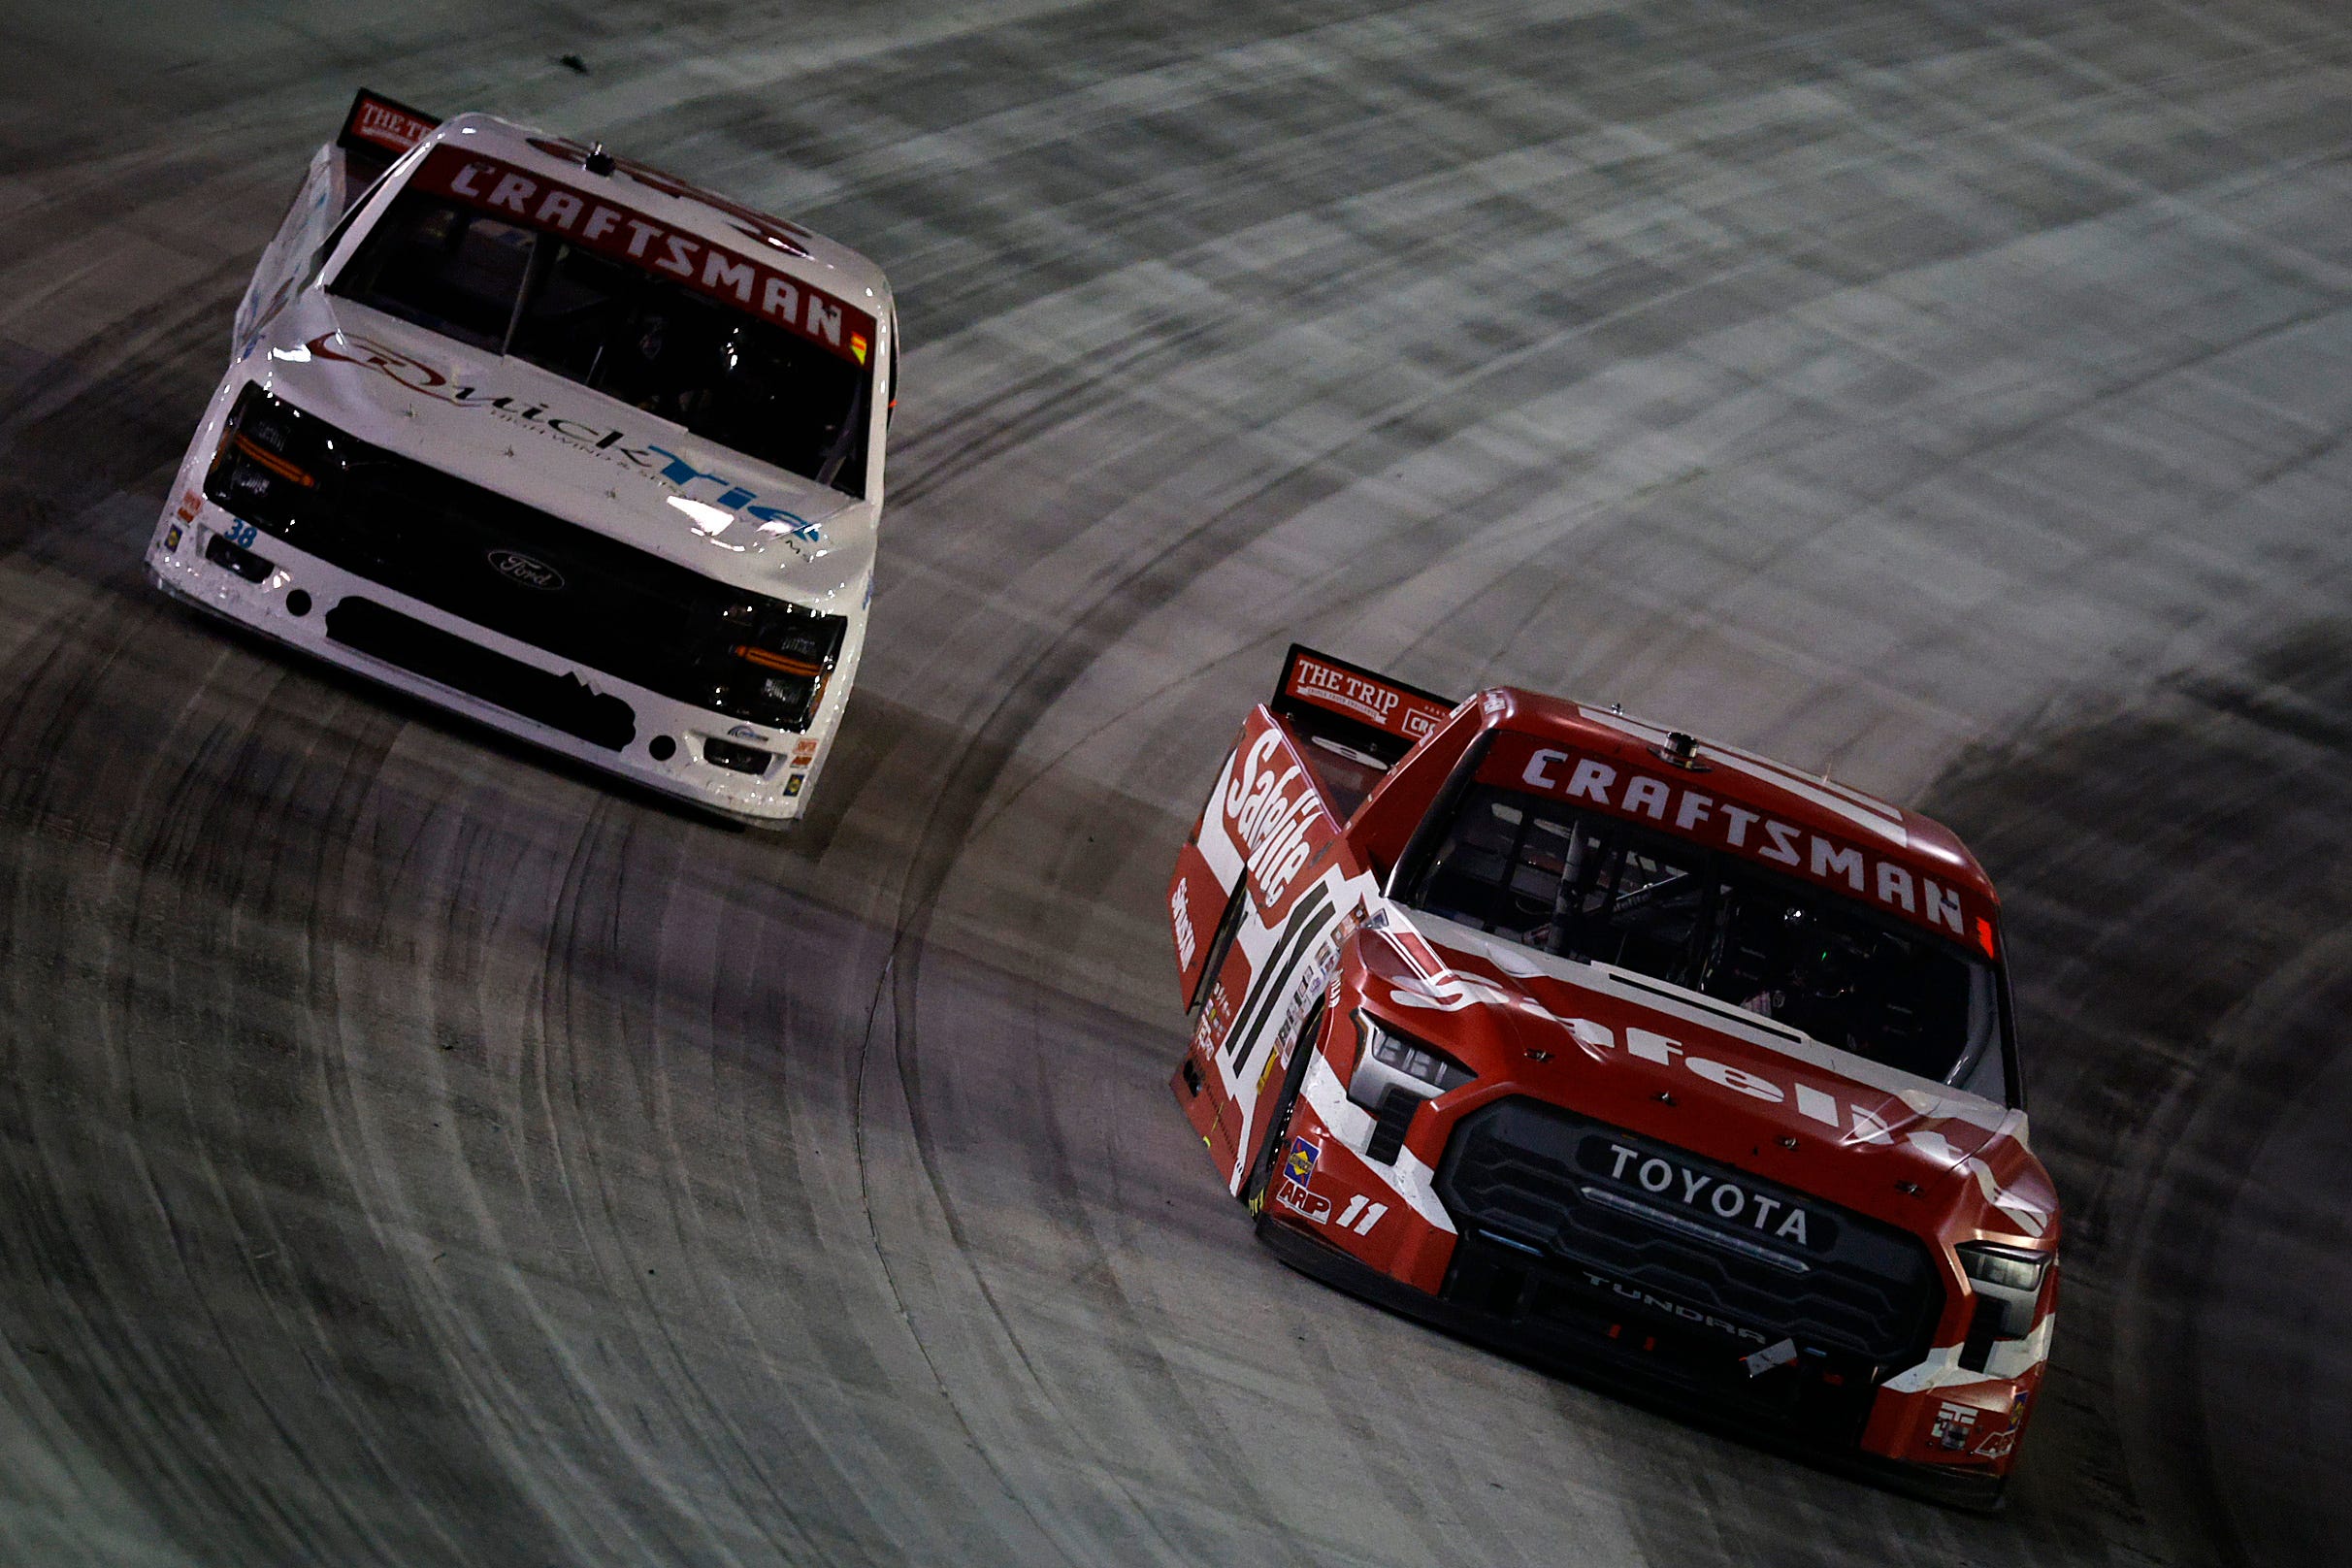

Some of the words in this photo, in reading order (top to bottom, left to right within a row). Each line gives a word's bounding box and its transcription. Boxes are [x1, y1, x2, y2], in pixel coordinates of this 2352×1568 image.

[362, 102, 406, 134] THE
[449, 161, 842, 347] CRAFTSMAN
[225, 517, 258, 550] 38
[500, 555, 553, 586] Ford
[1296, 659, 1345, 692] THE
[1346, 677, 1400, 716] TRIP
[1226, 728, 1324, 908] Safelite
[1521, 748, 1965, 936] CRAFTSMAN
[1225, 879, 1336, 1080] 11
[1388, 968, 2050, 1239] Safelite
[1277, 1180, 1331, 1218] ARP
[1335, 1193, 1389, 1237] 11
[1611, 1144, 1808, 1246] TOYOTA
[1583, 1270, 1767, 1346] TUNDRA
